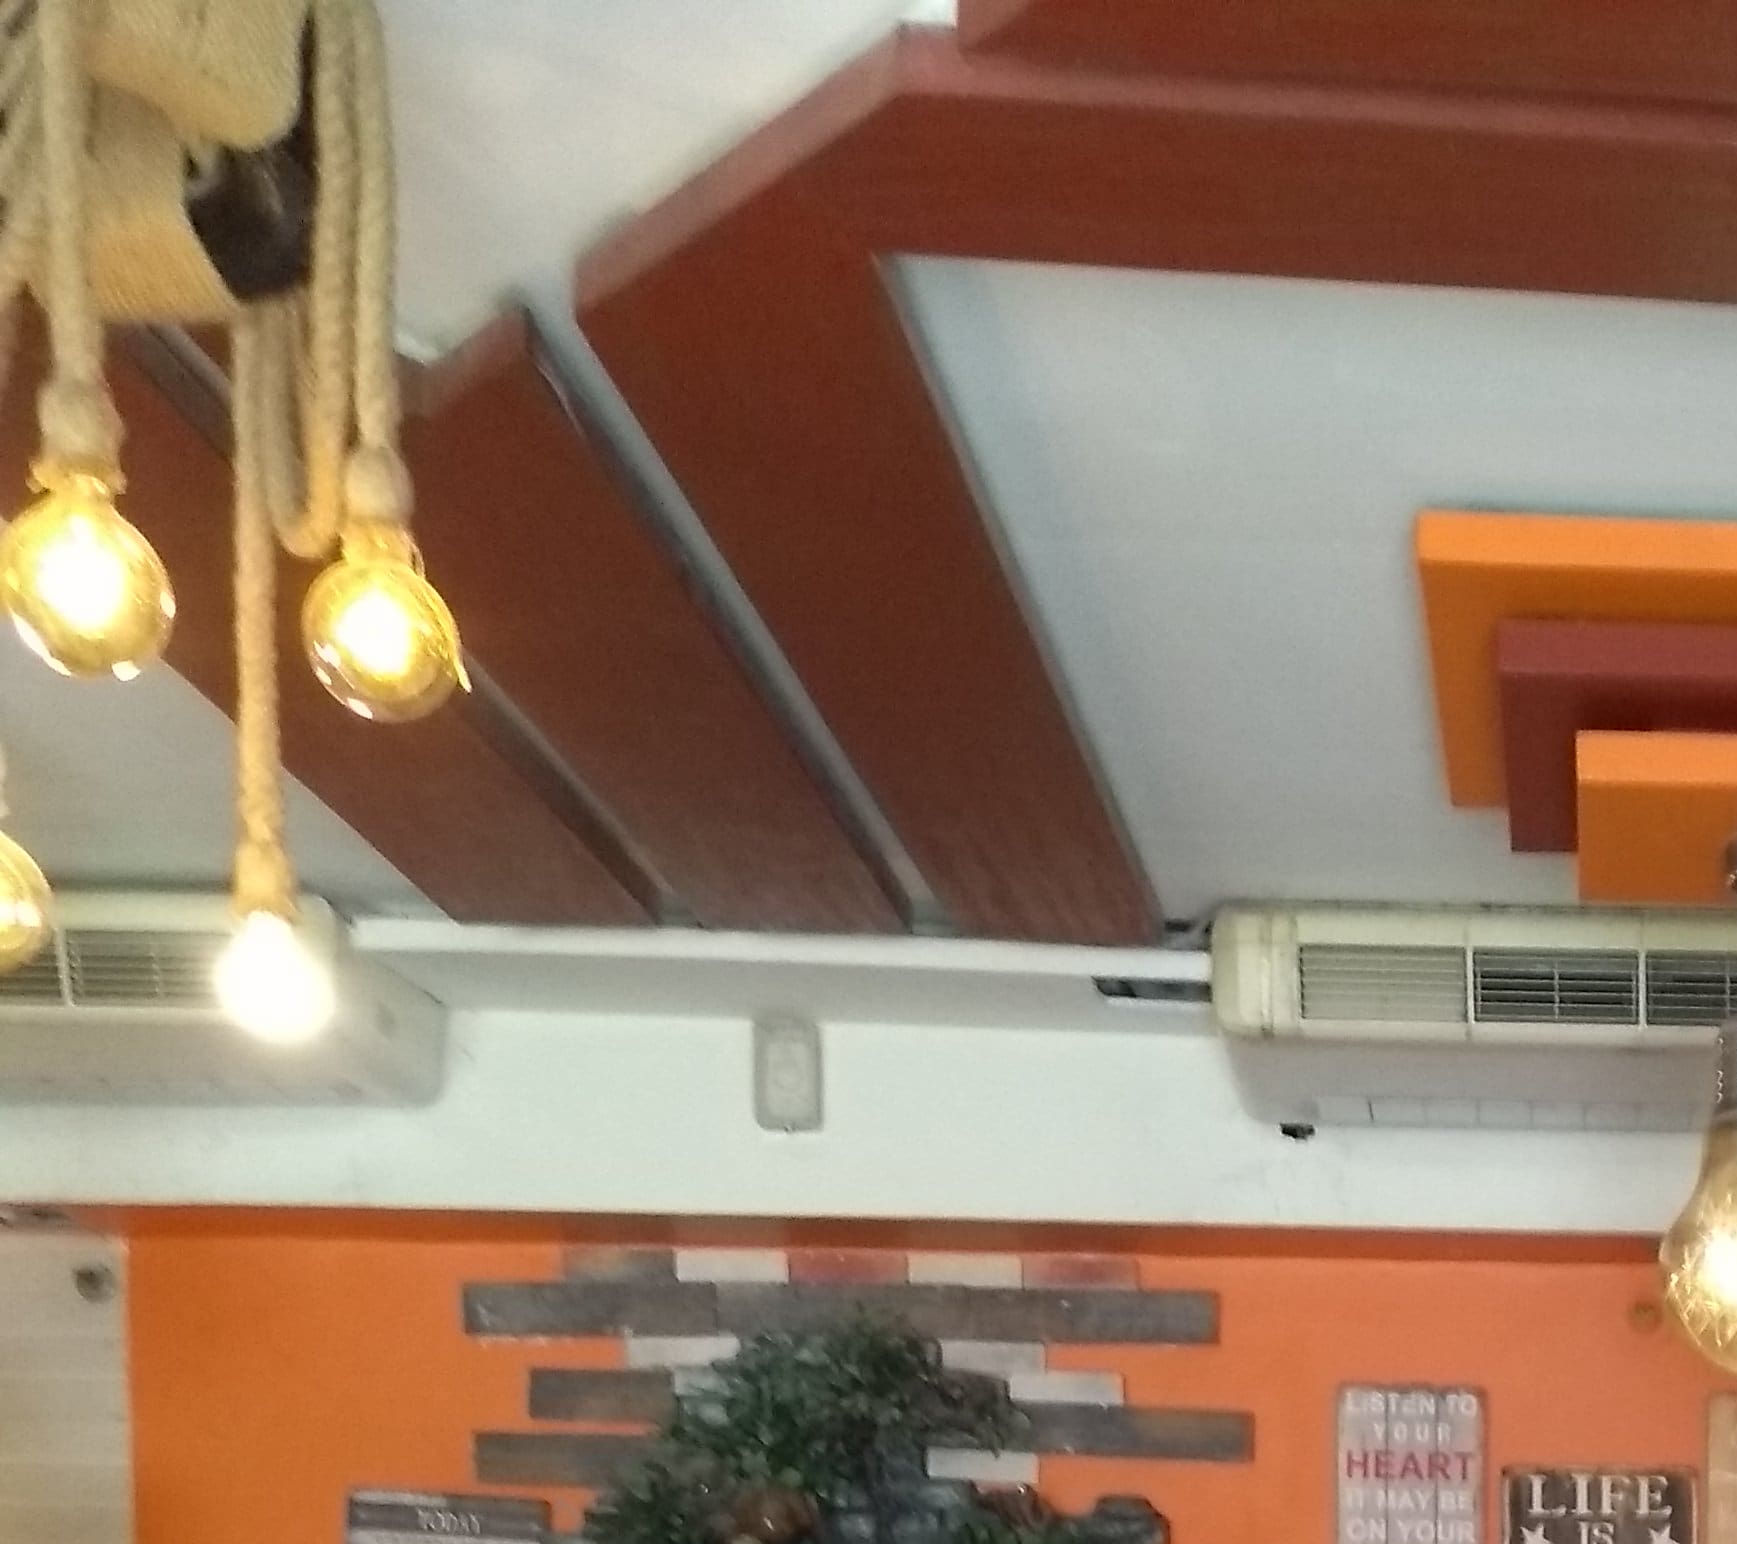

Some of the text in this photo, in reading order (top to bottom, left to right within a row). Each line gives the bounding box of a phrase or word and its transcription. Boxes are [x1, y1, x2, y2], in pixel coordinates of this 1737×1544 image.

[1346, 1392, 1477, 1416] LISTEN TO
[1373, 1422, 1452, 1442] YOUR
[1346, 1450, 1473, 1480] HEART
[1527, 1472, 1673, 1518] LIFE
[1346, 1518, 1475, 1544] ON YOUR
